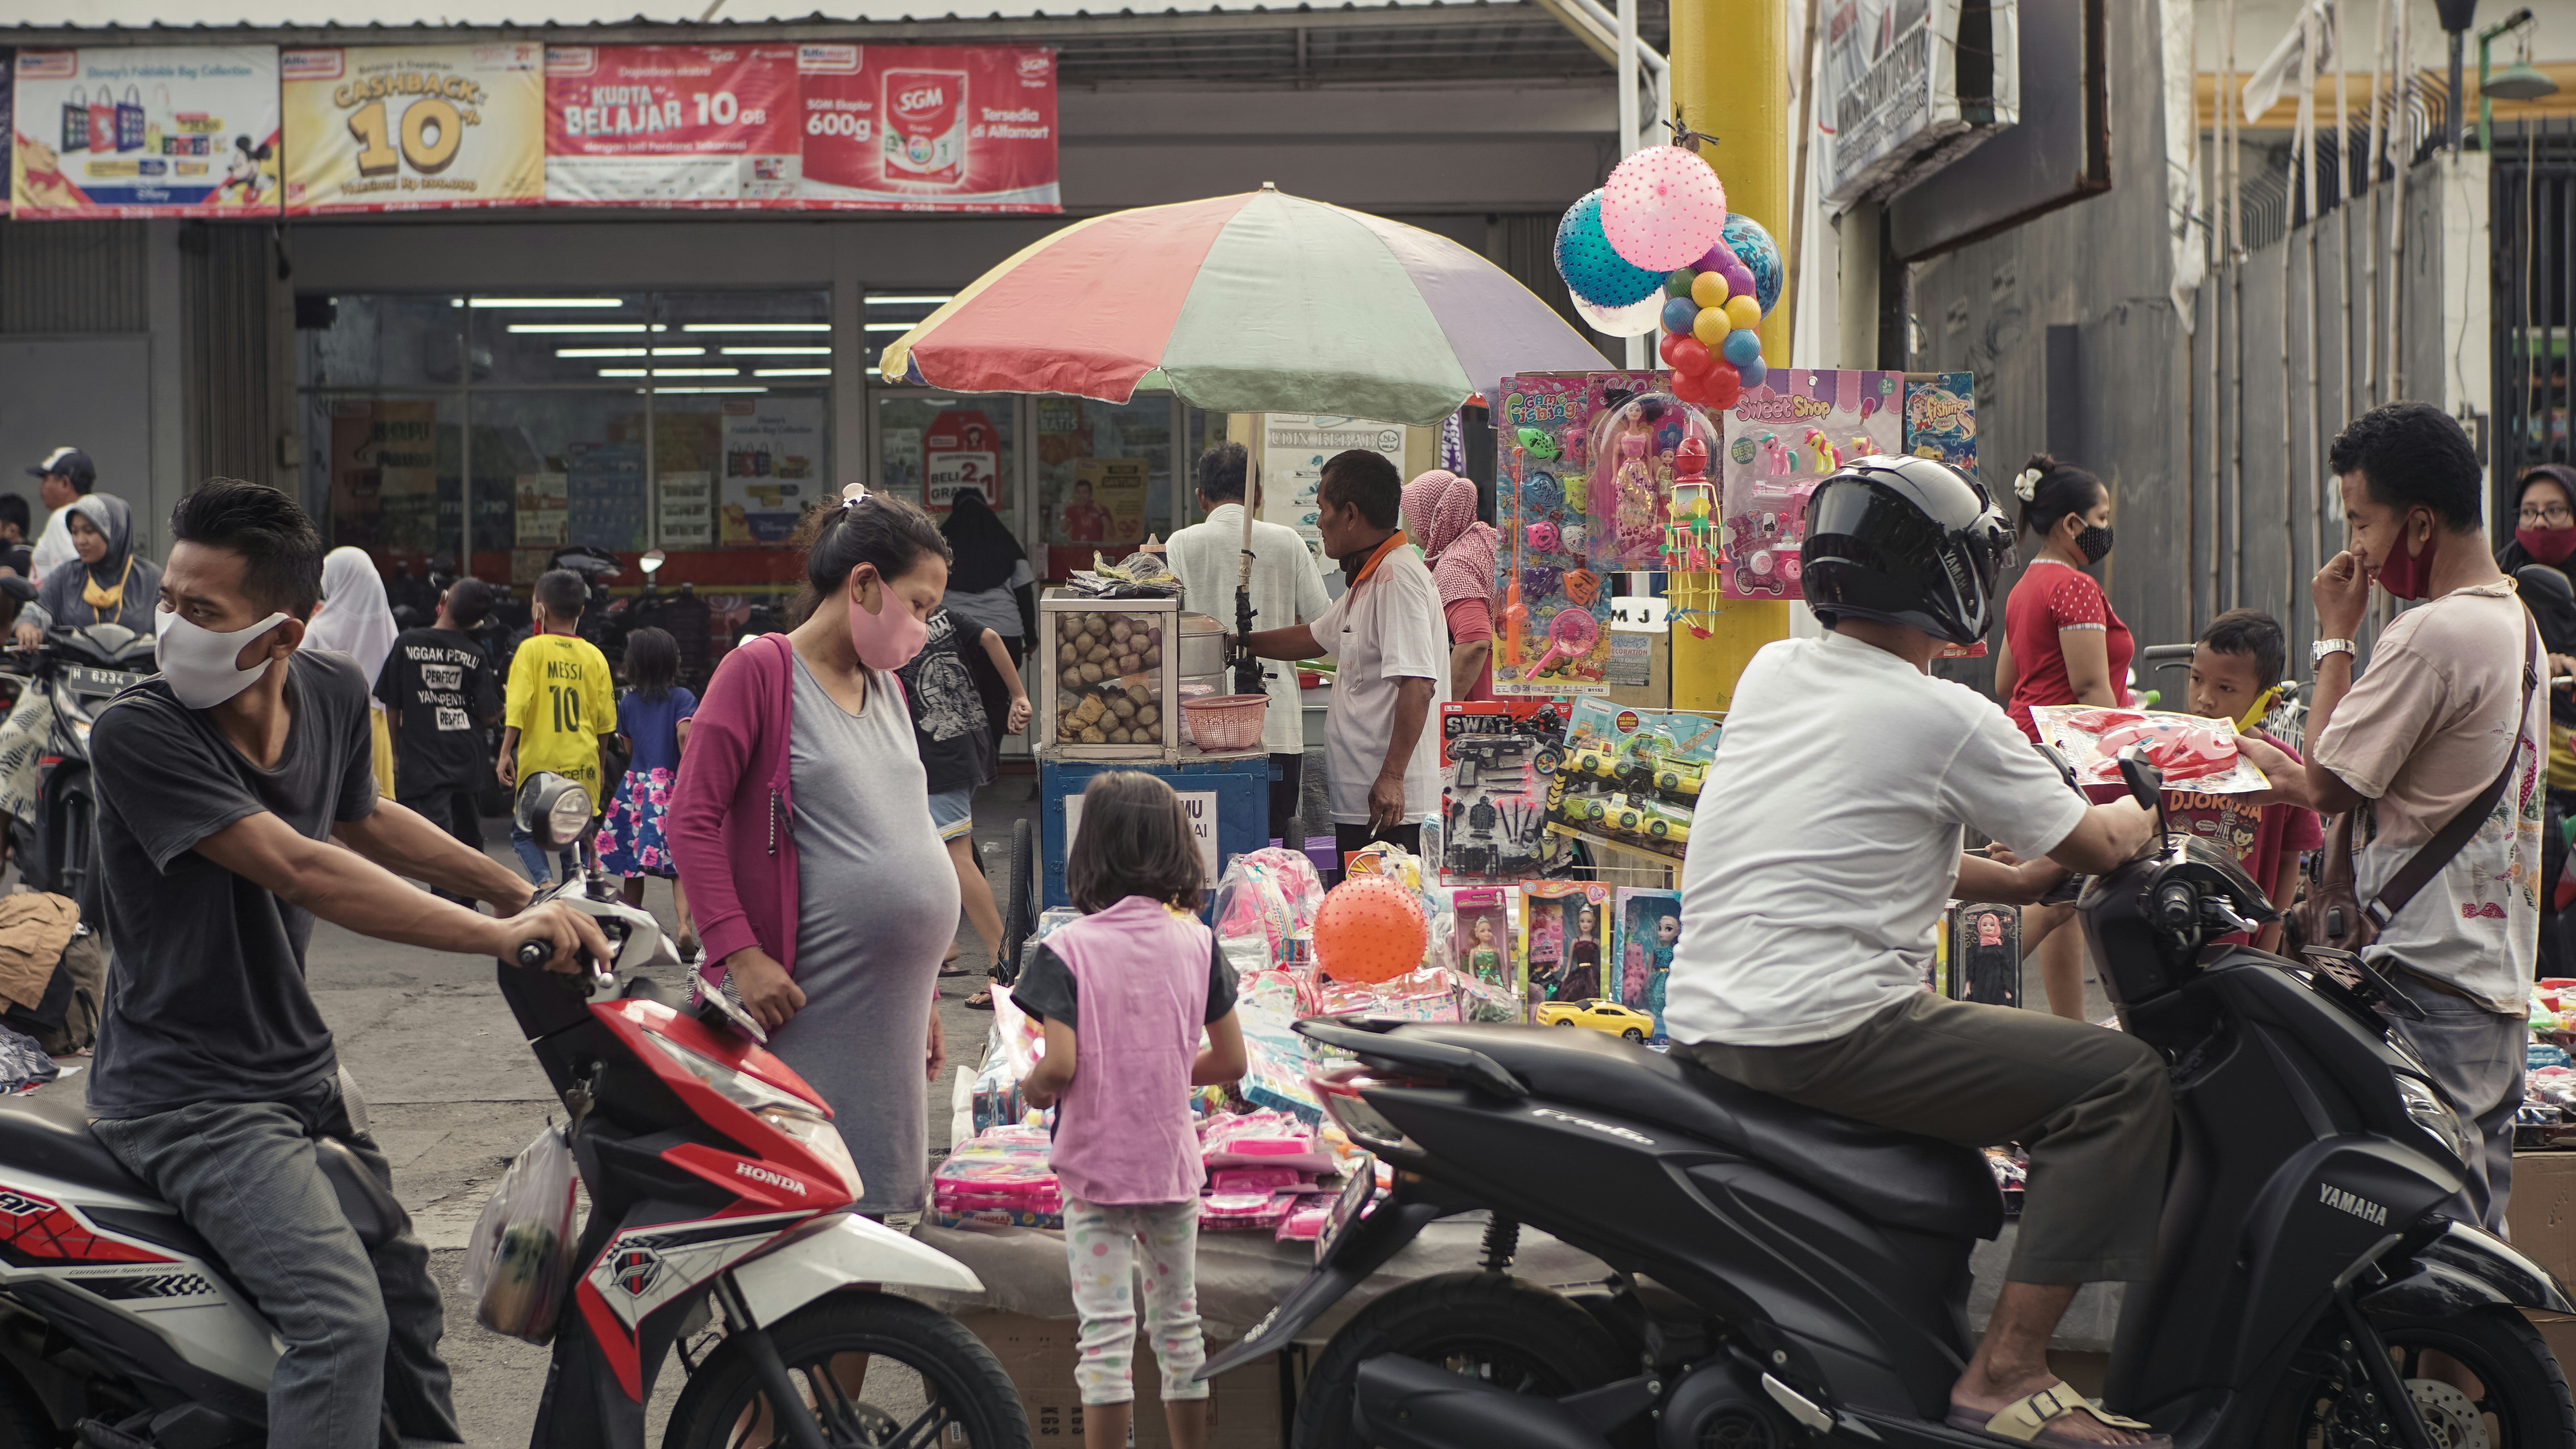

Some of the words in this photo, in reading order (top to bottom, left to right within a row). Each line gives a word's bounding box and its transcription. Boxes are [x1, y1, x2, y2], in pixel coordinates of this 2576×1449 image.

[545, 52, 587, 61] lfamart
[334, 72, 481, 108] CASHBACK
[592, 85, 653, 107] KUOTA
[899, 87, 944, 112] SGM
[693, 91, 738, 125] 10
[739, 109, 766, 124] GB
[806, 99, 833, 109] SGM
[563, 100, 682, 137] BELAJAR
[981, 108, 1039, 122] Tersedia
[806, 113, 871, 142] 600g
[972, 125, 986, 139] di
[988, 125, 1049, 139] Alfamart
[1882, 379, 1893, 389] 3+
[1524, 392, 1568, 408] GAME
[1736, 395, 1792, 421] Sweet
[1792, 394, 1831, 419] Shop
[1925, 395, 1969, 423] fishing
[1040, 418, 1078, 430] RATIS
[1270, 431, 1309, 446] UDIN
[1316, 432, 1376, 447] KEBAB
[1732, 444, 1755, 457] BEST
[931, 471, 960, 484] BELI
[961, 461, 978, 482] 2
[979, 473, 994, 498] 1
[406, 646, 444, 662] NGGAK
[446, 648, 480, 670] PERLU
[73, 668, 81, 680] H
[425, 670, 461, 685] PERFECT
[548, 660, 583, 681] MESSI
[549, 685, 580, 733] 10
[1446, 717, 1509, 734] SWAT
[557, 764, 586, 781] icef
[736, 1161, 807, 1197] HONDA
[2319, 1182, 2388, 1227] YAMAHA
[122, 1264, 185, 1274] Sportmatic
[1040, 1407, 1059, 1436] KGS
